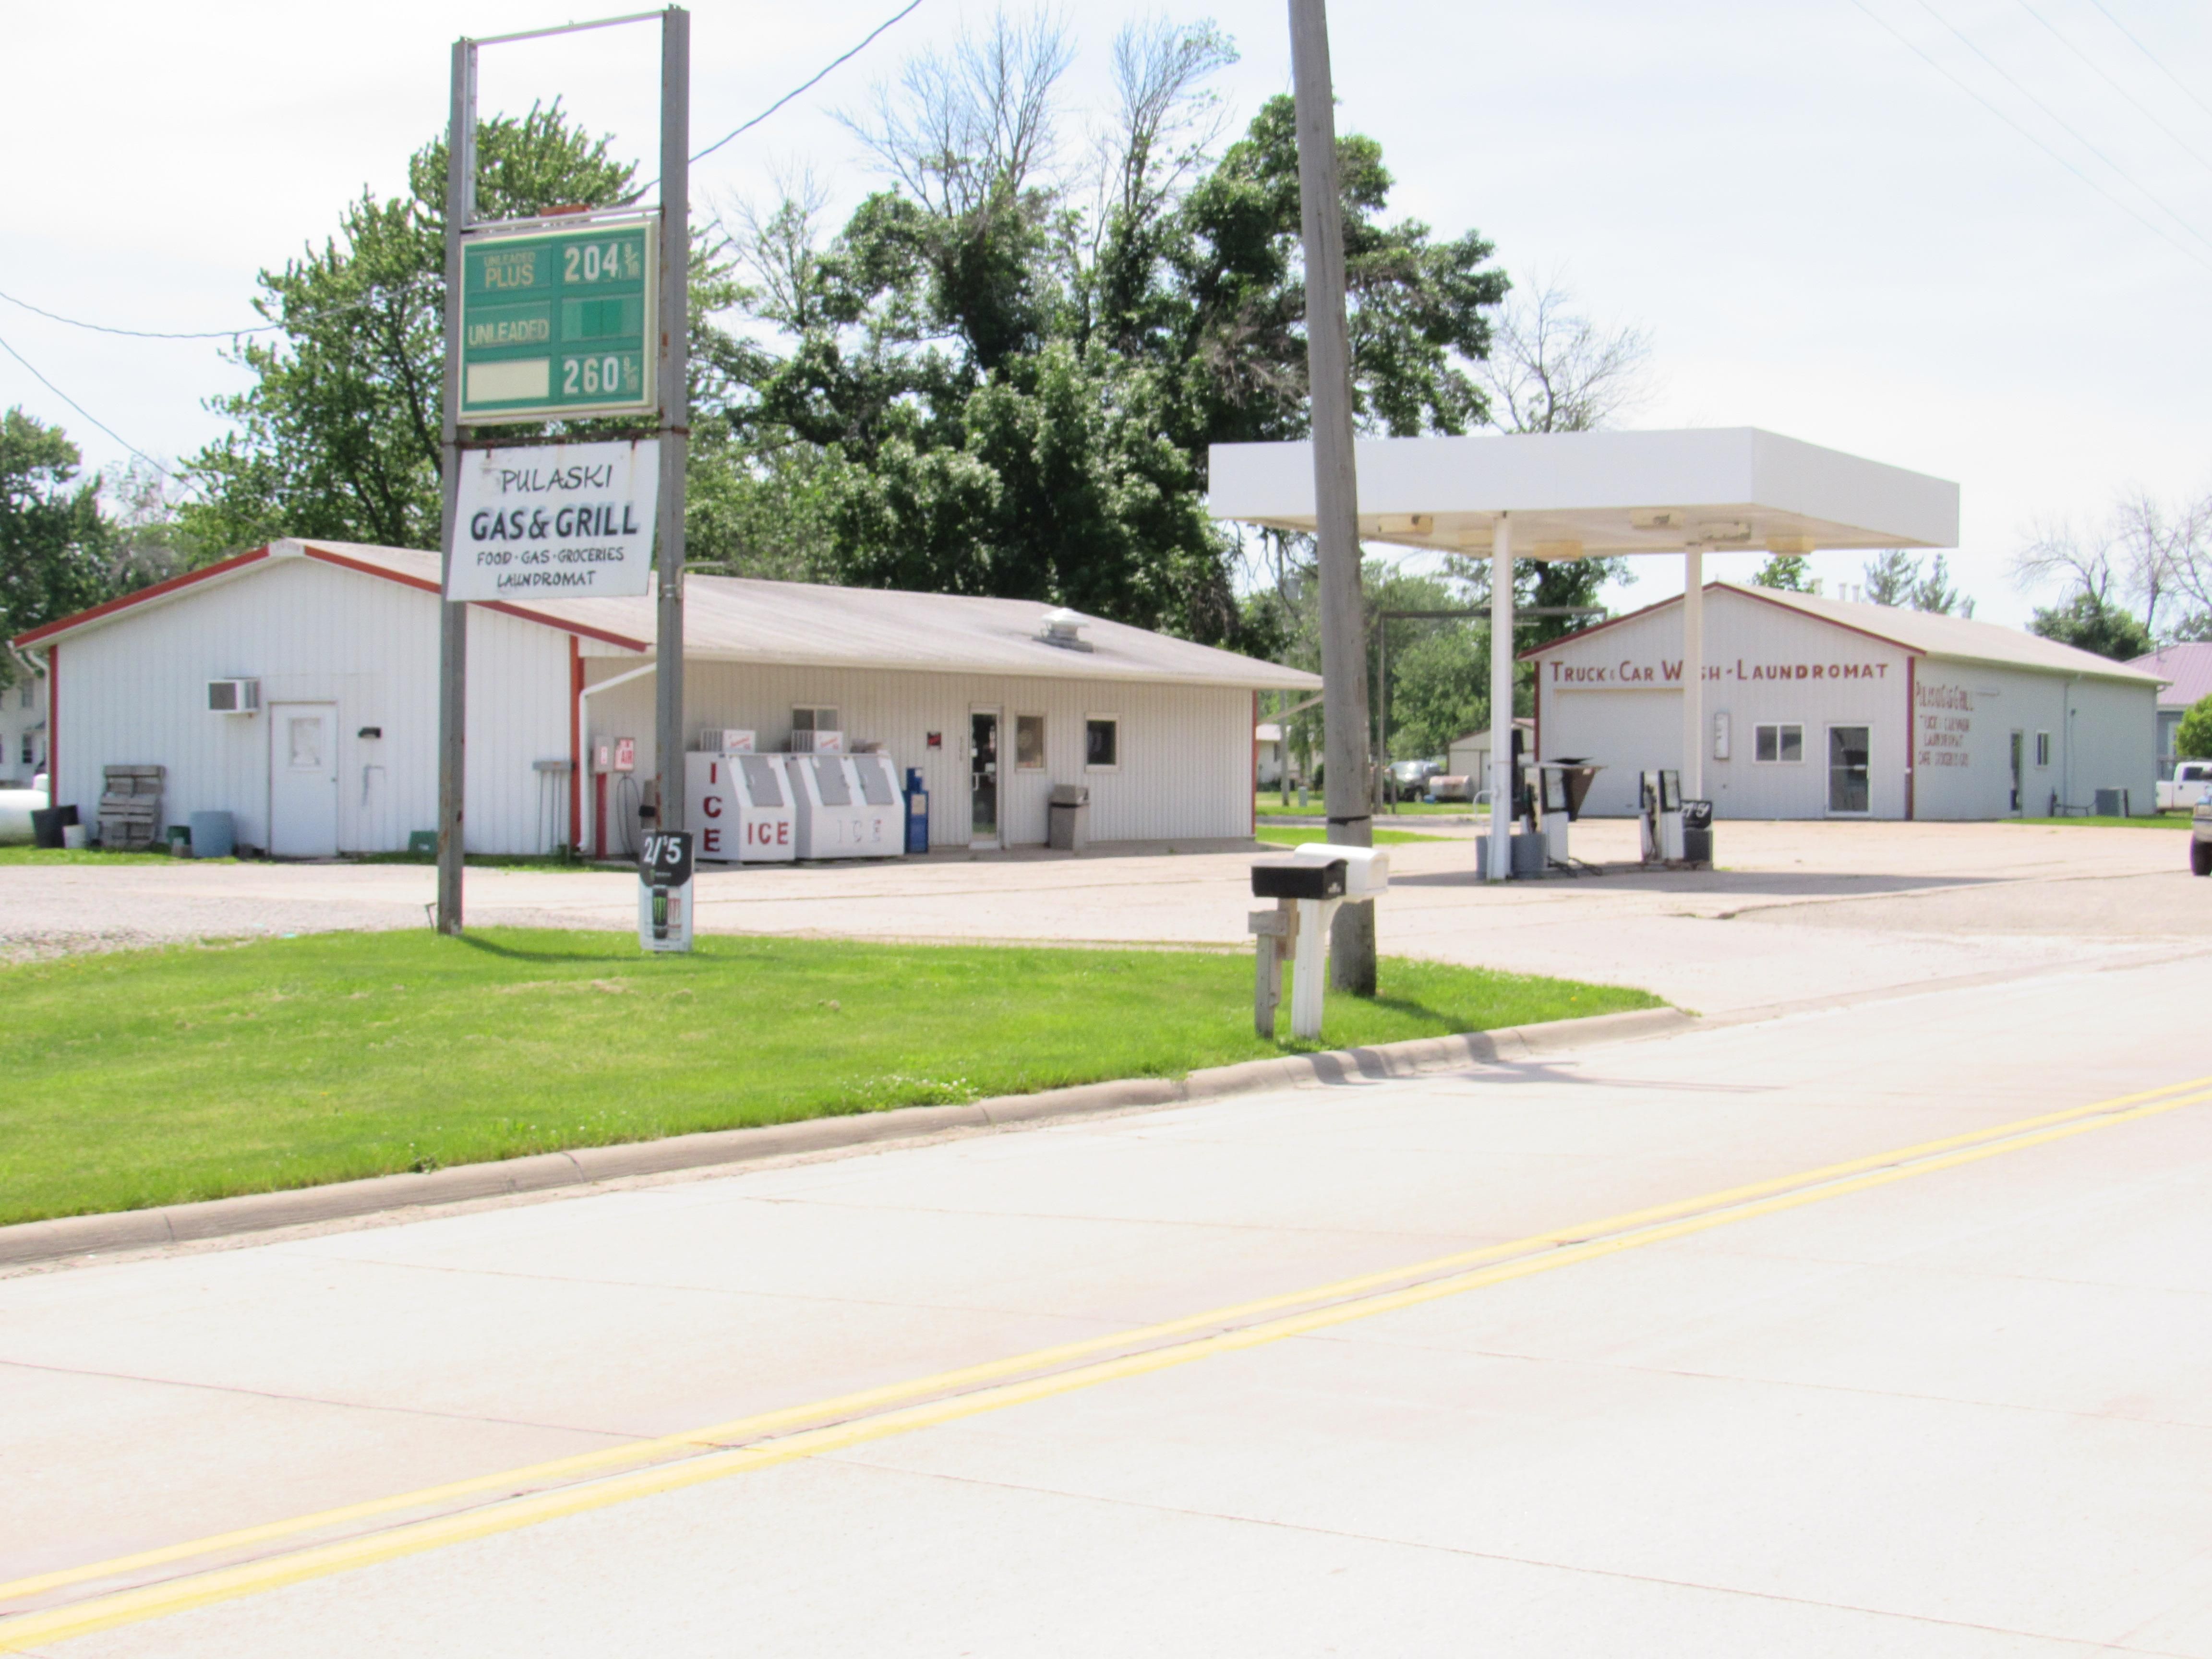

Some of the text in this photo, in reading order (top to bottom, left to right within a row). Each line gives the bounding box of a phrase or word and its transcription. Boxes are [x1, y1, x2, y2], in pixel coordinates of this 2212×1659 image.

[565, 243, 618, 282] 204
[485, 264, 534, 288] PLUS
[468, 318, 550, 345] UNLEADED
[563, 357, 619, 394] 260
[501, 464, 612, 493] PULASKI
[555, 505, 637, 538] GRILL
[477, 546, 624, 565] FOOD GAS GROCERIES
[497, 570, 596, 588] LAUNDROMAT
[1619, 660, 1654, 682] CAR
[1661, 660, 1719, 681] WH
[748, 822, 789, 845] ICE
